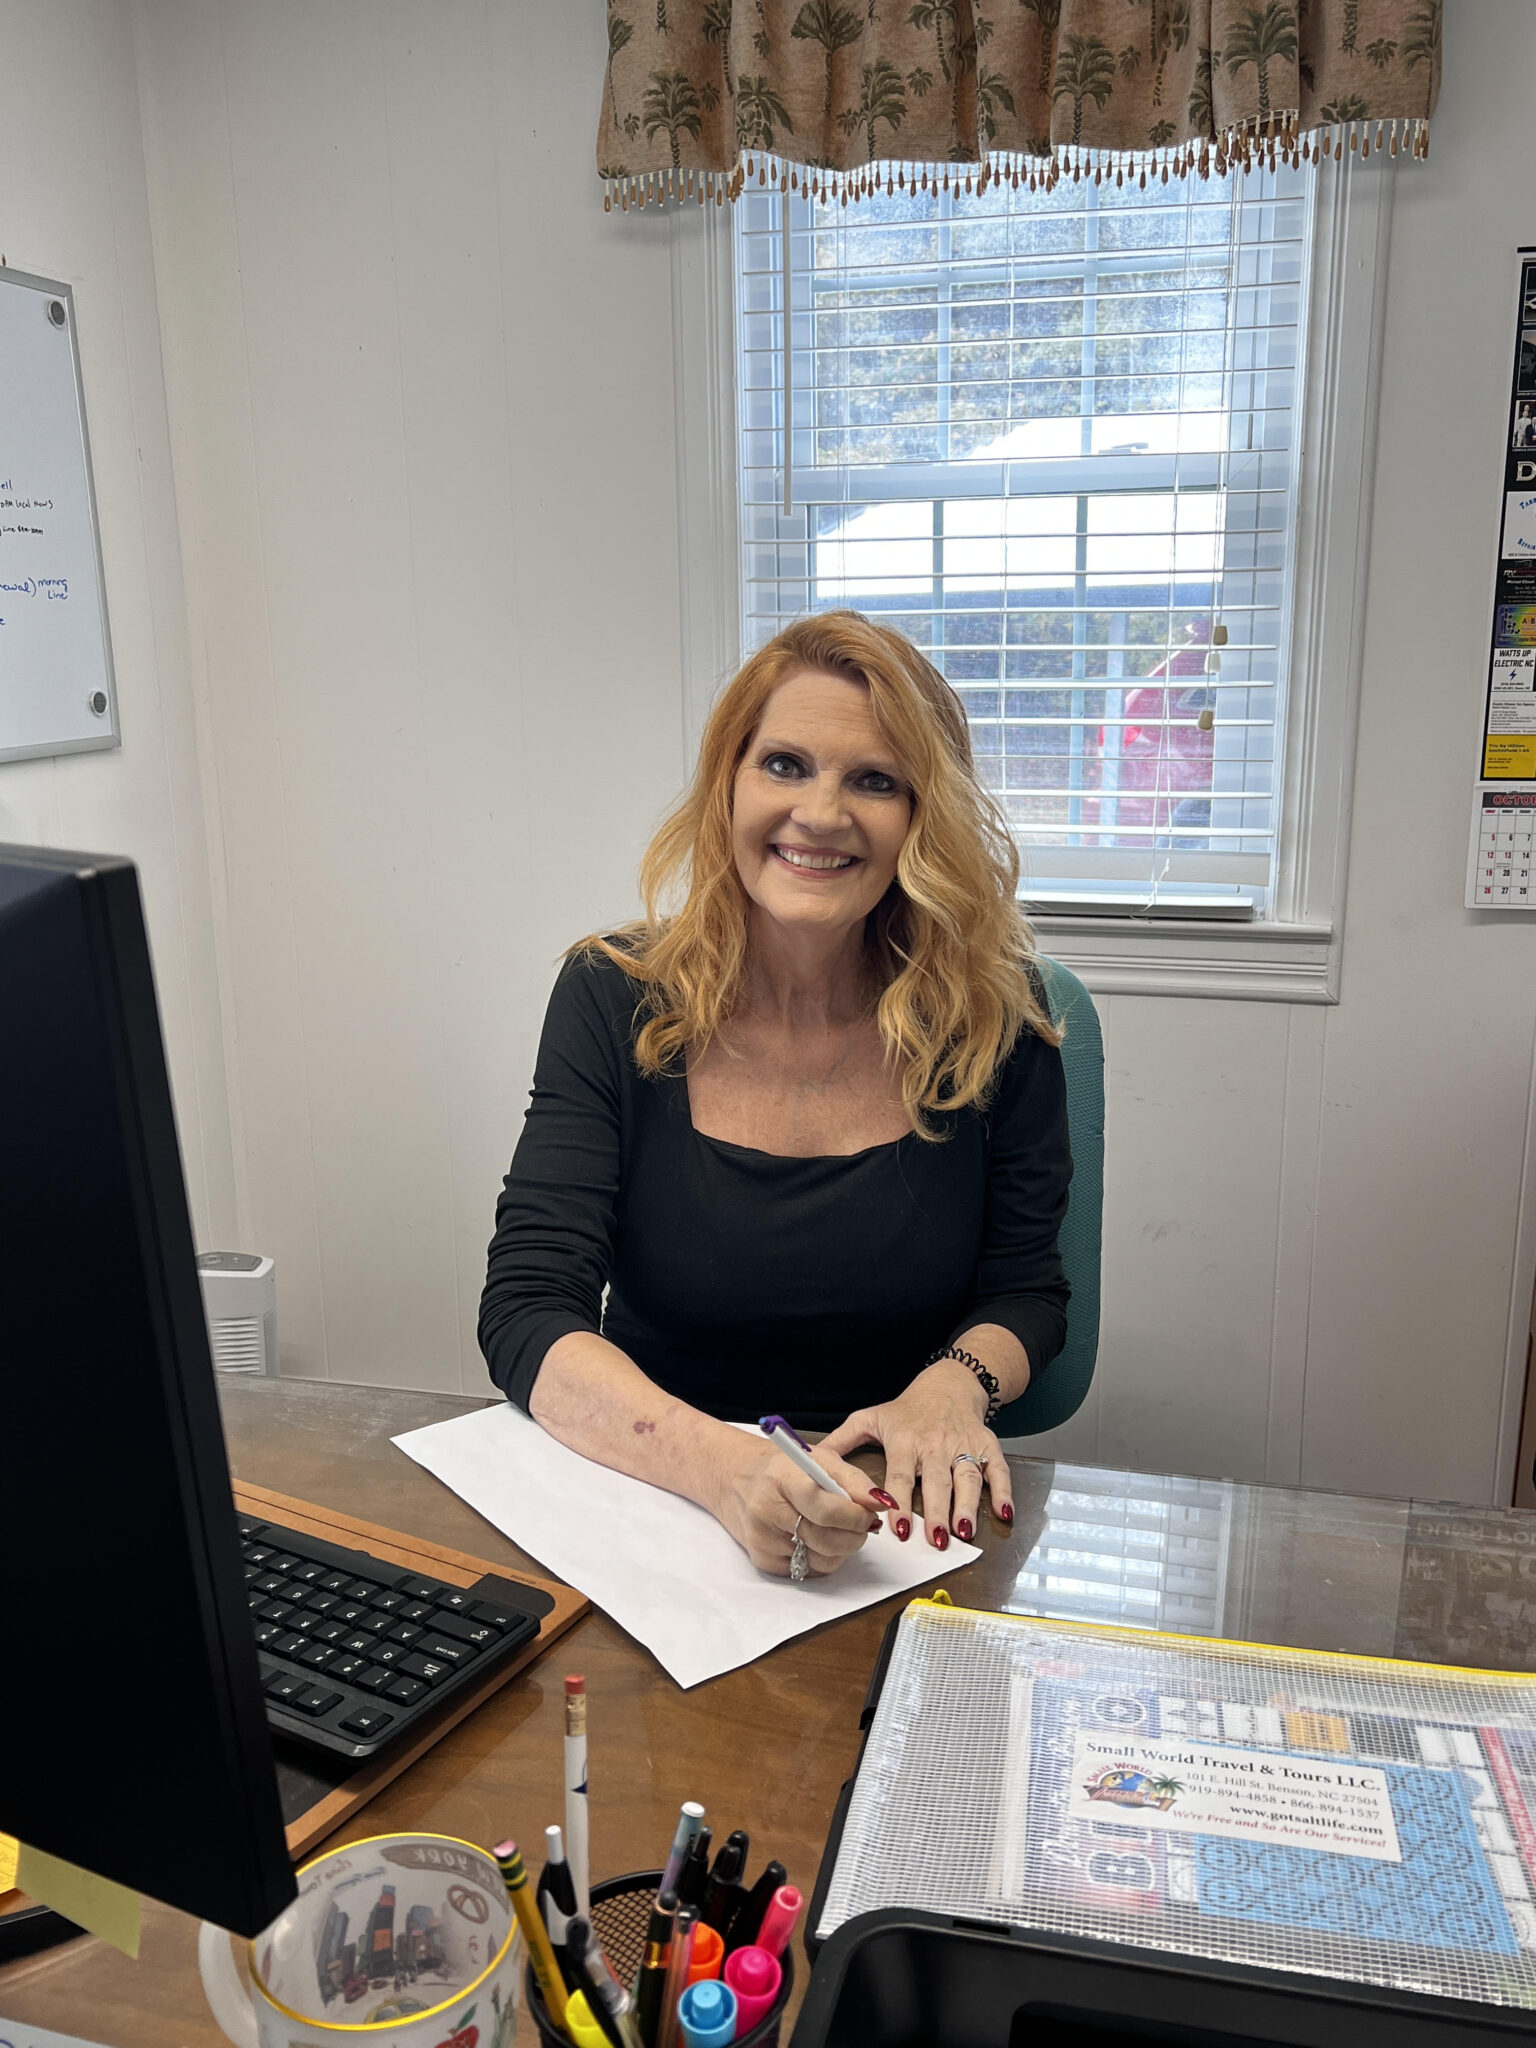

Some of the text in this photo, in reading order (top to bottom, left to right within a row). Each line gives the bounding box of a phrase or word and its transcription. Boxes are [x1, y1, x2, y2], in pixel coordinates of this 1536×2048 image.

[1494, 660, 1534, 668] ELECTRIC NC
[1086, 1742, 1380, 1791] Small World Travel & Tours LLC.
[1114, 1762, 1153, 1776] WORLD
[1186, 1772, 1205, 1782] 101
[1224, 1776, 1246, 1787] Hill
[1268, 1783, 1315, 1798] Benson,
[1318, 1790, 1340, 1800] NC
[1340, 1794, 1378, 1806] 27504
[1188, 1784, 1380, 1820] 919-894-4858 866-894-1537
[1172, 1810, 1386, 1848] We're Free and So Are Our Services!
[1230, 1806, 1384, 1835] www.gotsaltlife.com
